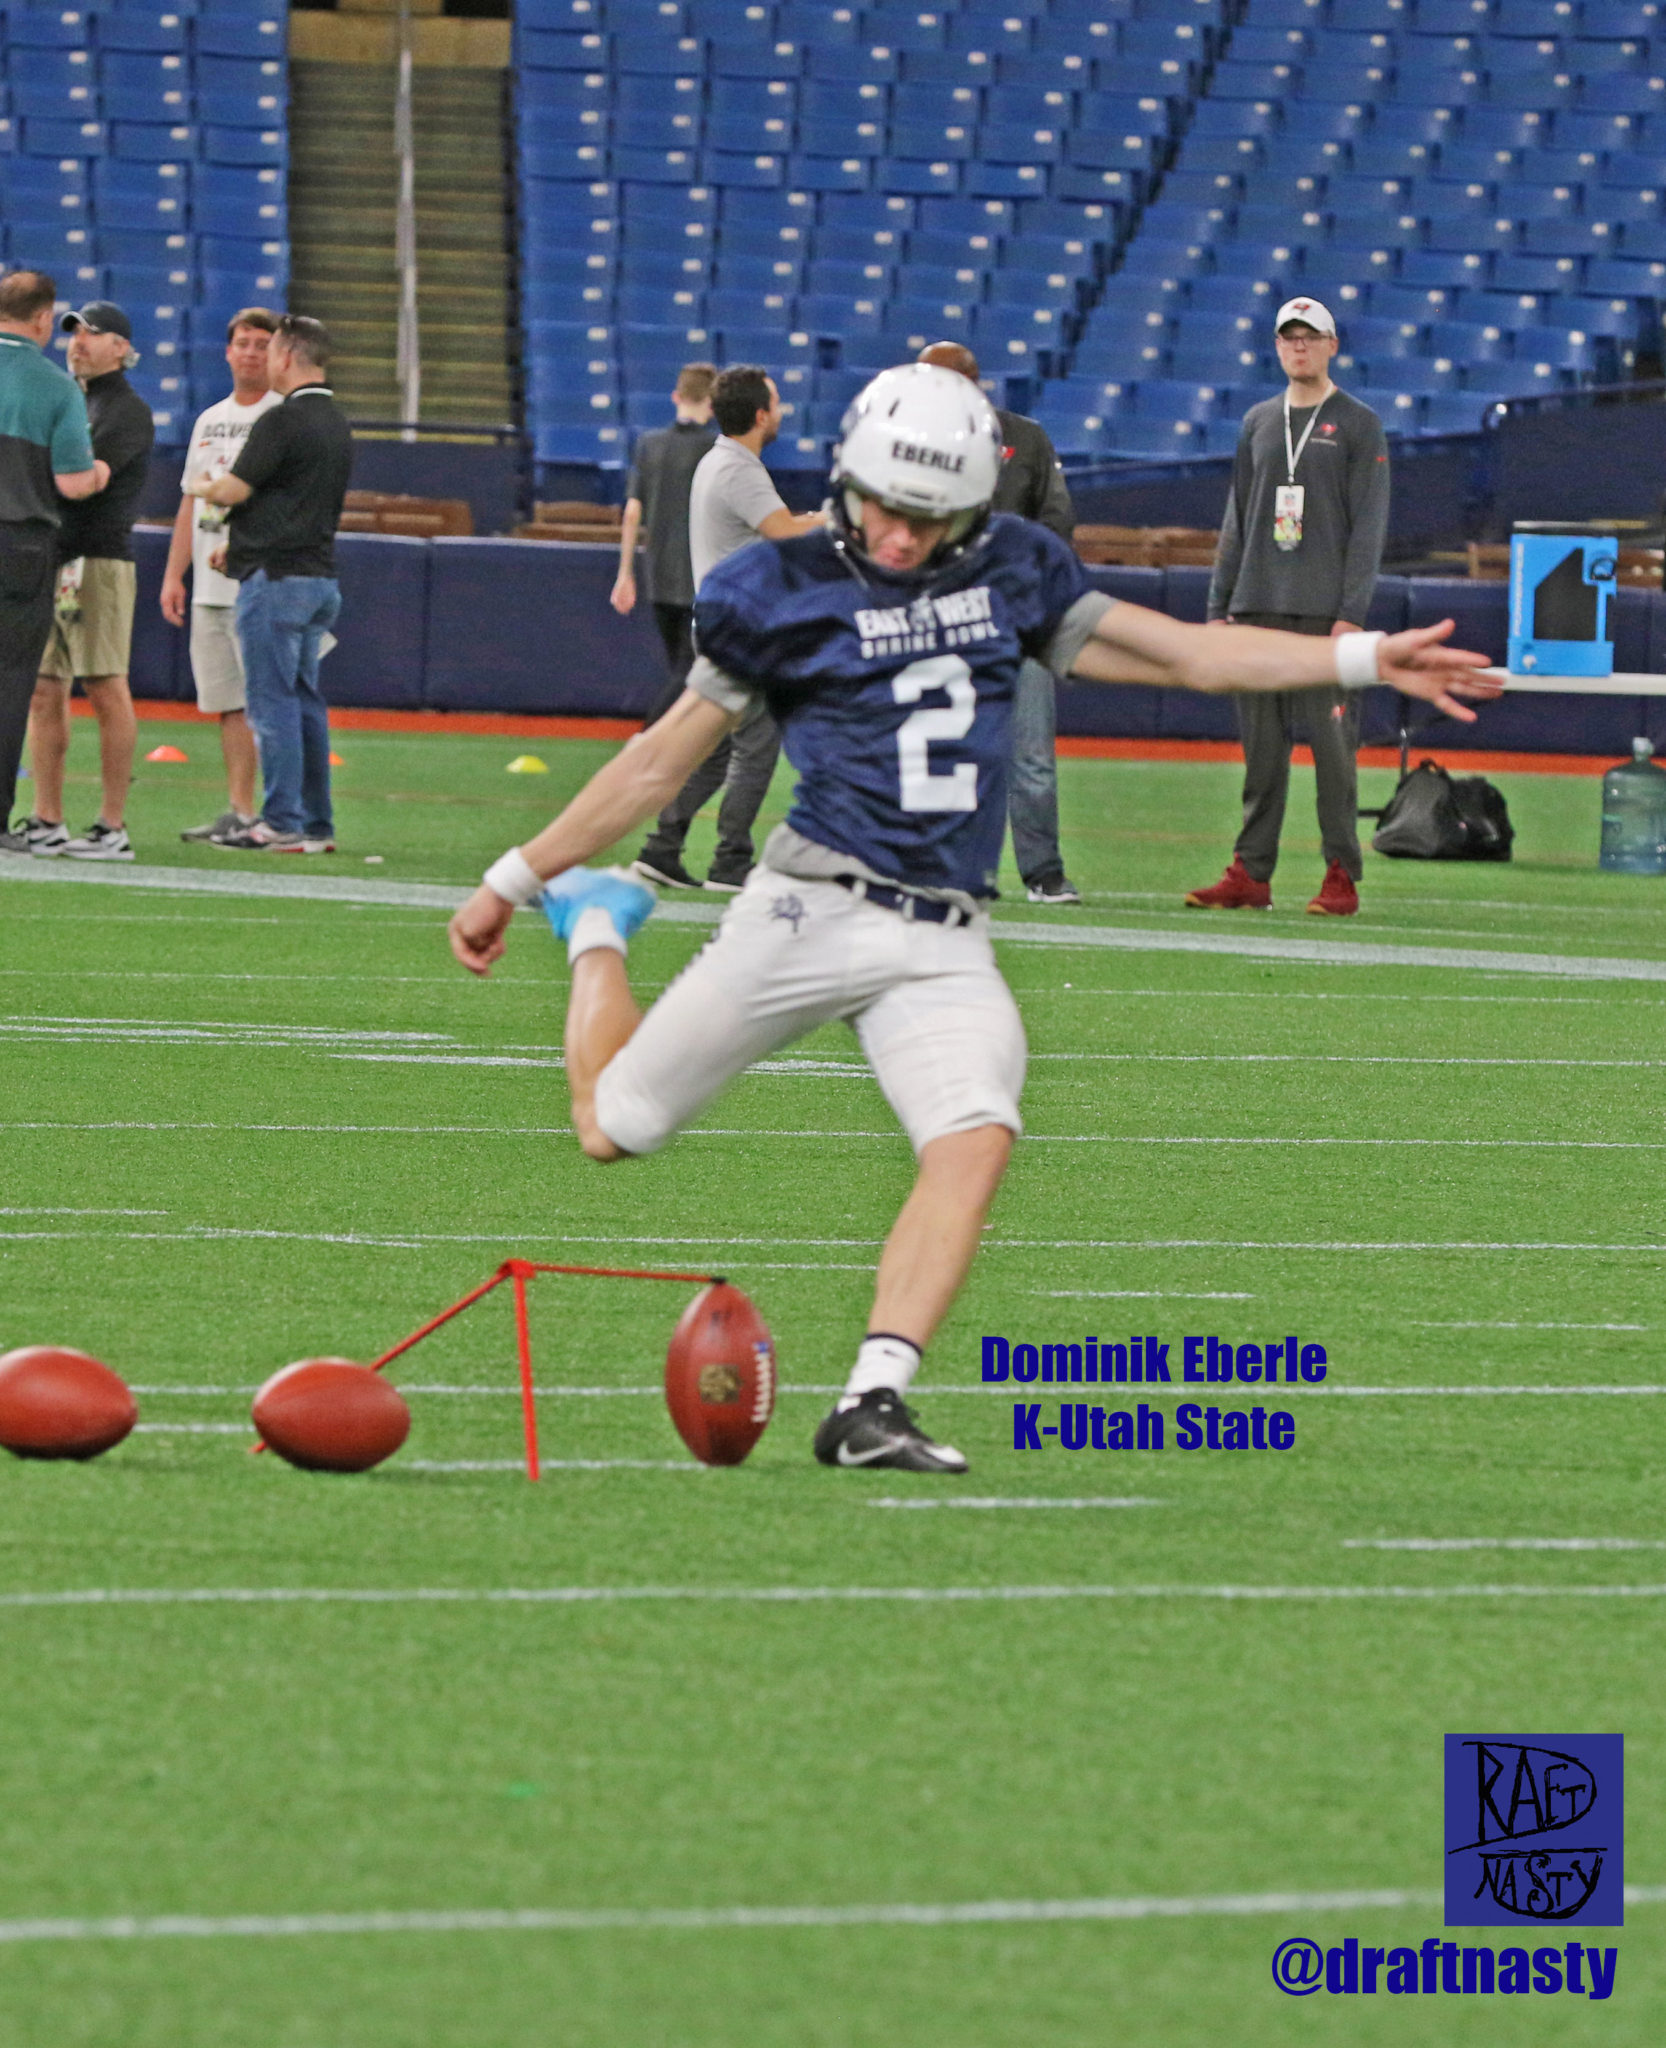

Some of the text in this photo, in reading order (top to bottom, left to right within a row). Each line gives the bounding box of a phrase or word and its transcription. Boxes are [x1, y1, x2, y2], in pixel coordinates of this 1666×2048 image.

[891, 440, 965, 474] EBERLE
[854, 585, 992, 640] EAST WEST
[860, 620, 1000, 659] SHRINE BOWL
[891, 653, 978, 812] 2
